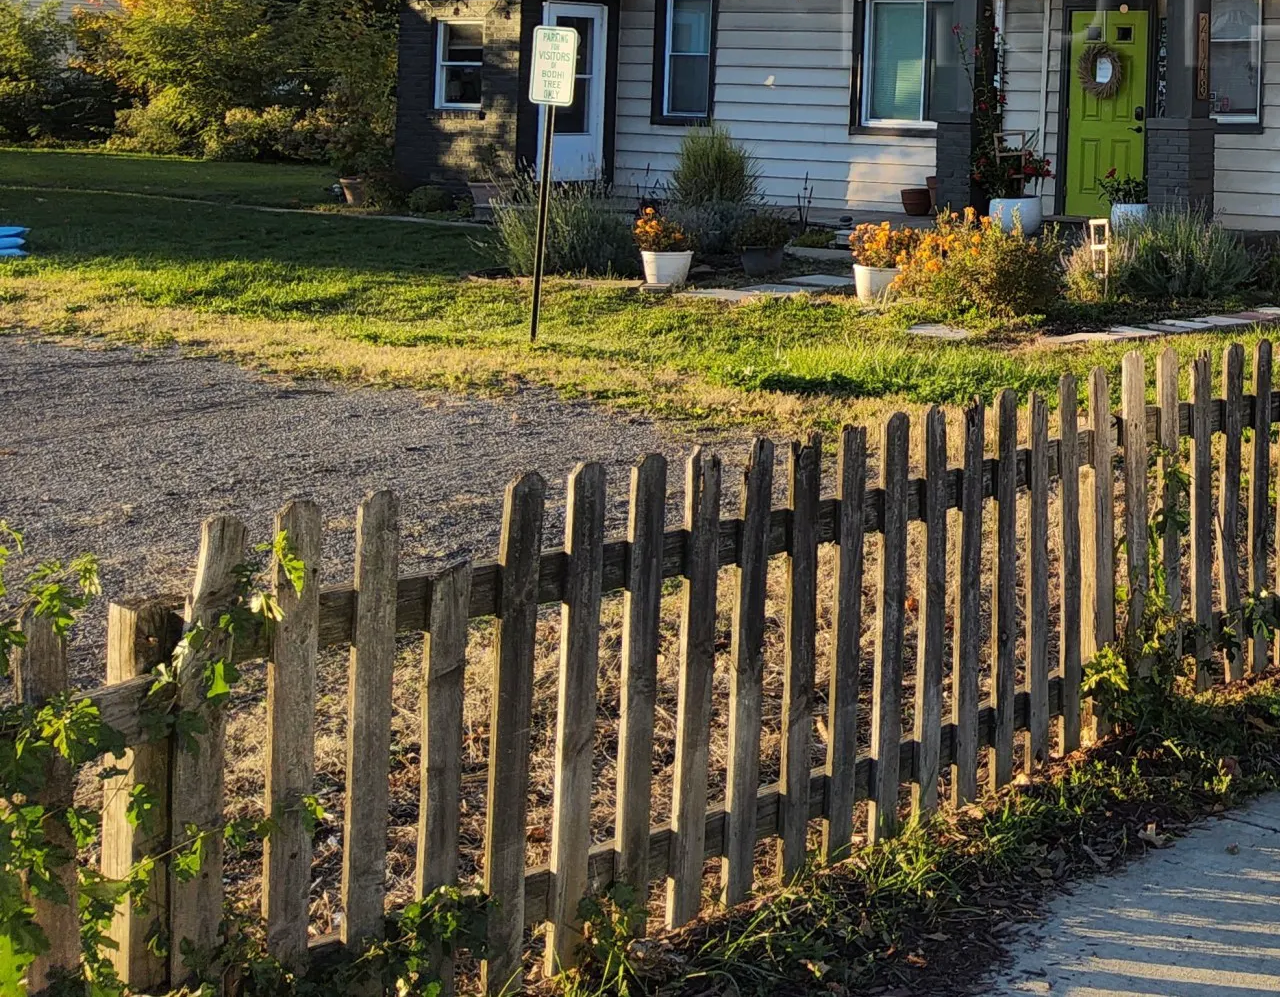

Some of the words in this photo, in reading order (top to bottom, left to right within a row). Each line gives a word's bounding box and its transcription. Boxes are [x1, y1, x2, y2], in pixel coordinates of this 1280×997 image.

[543, 32, 569, 44] PARKING
[539, 51, 571, 62] VISITORS
[541, 70, 565, 80] BODHI
[543, 80, 562, 89] TREE
[543, 90, 560, 100] ONLY
